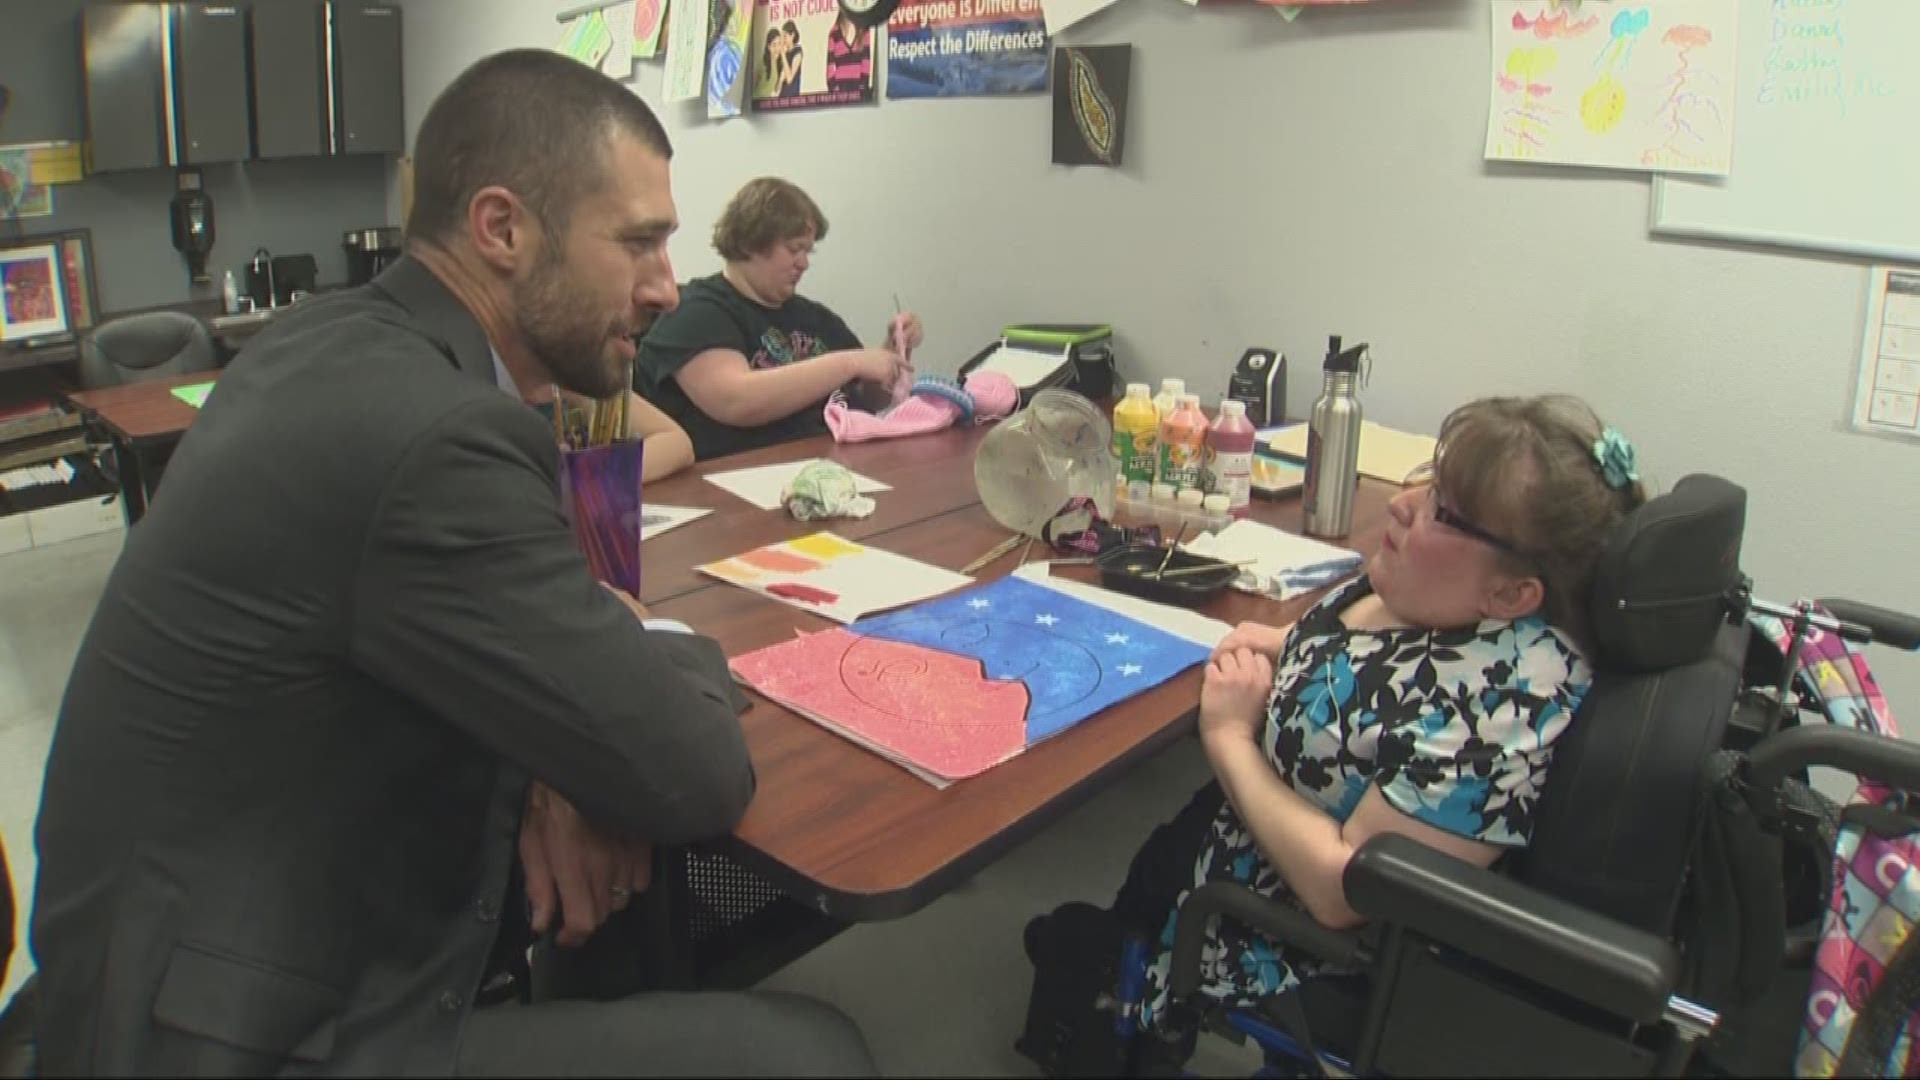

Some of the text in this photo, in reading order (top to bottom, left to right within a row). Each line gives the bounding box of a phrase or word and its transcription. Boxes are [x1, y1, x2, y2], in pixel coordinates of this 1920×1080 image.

[770, 0, 837, 22] IS NOT COOL
[960, 0, 972, 18] is
[889, 29, 1044, 63] Respect the Differences
